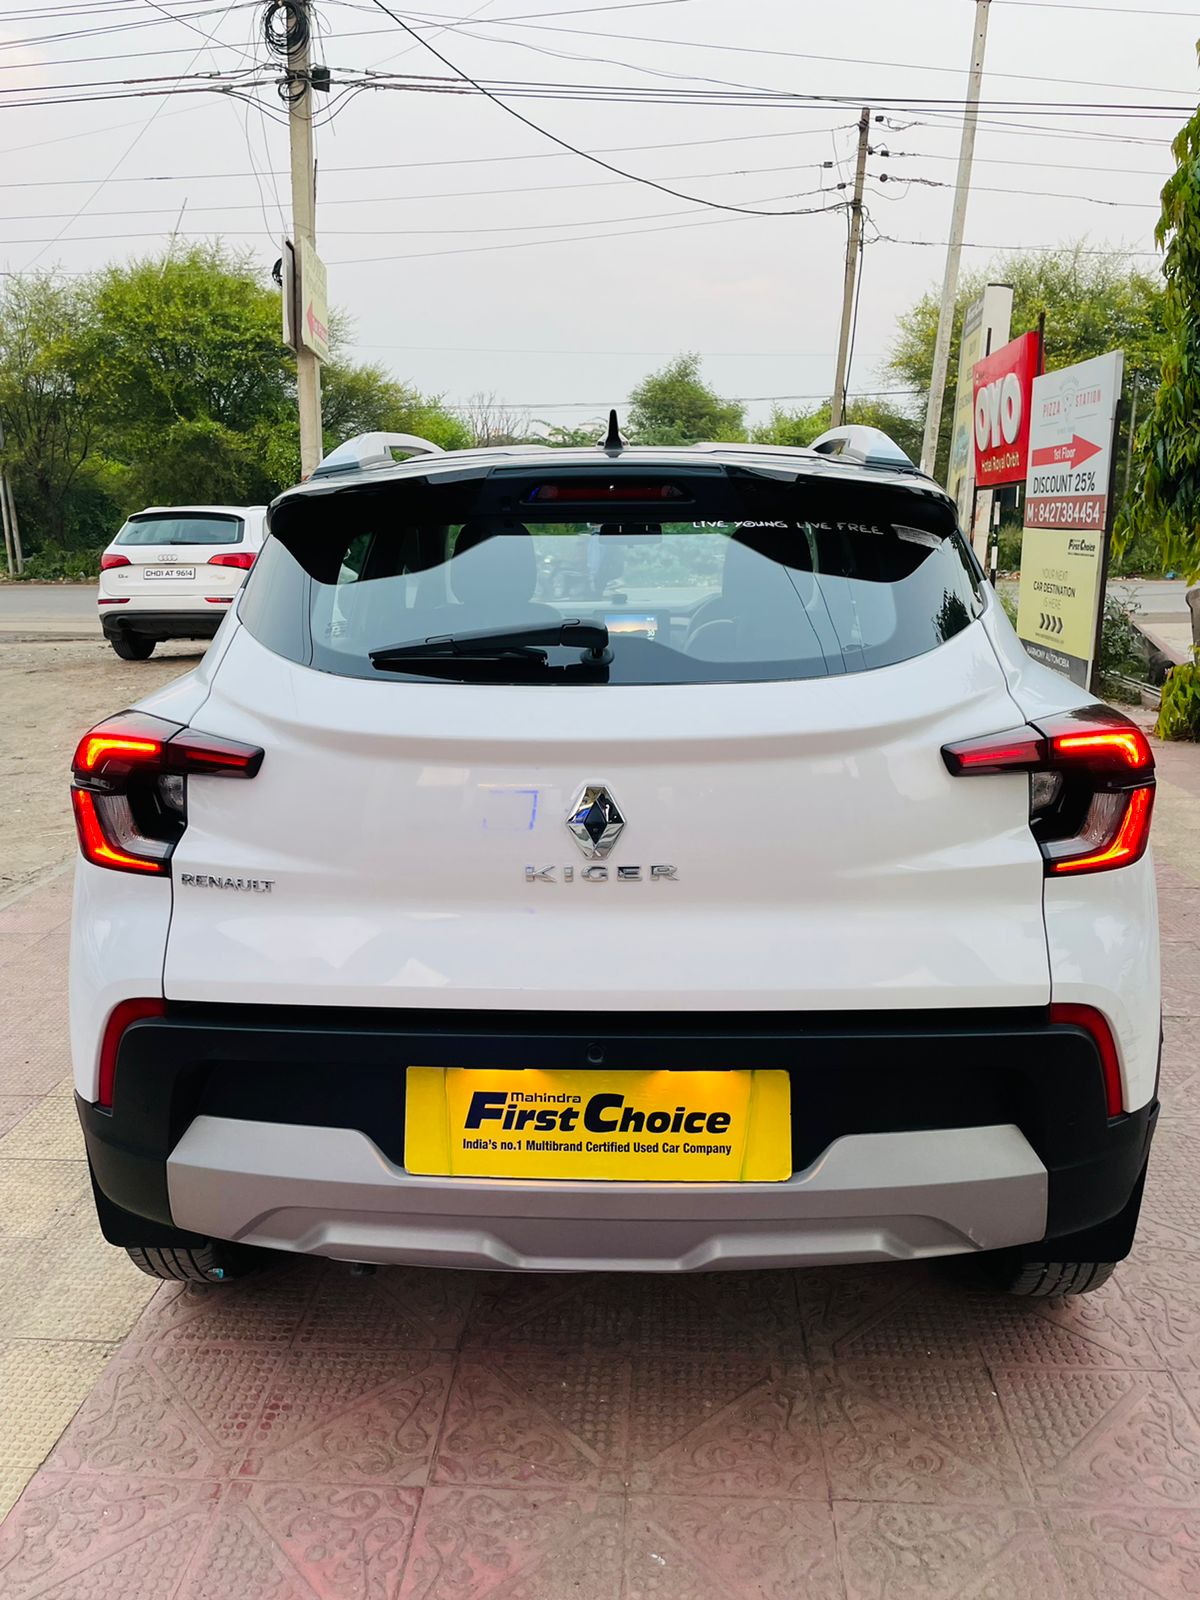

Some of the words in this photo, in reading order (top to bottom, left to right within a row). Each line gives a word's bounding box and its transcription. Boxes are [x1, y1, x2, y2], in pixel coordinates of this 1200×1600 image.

[975, 372, 1021, 452] OYO
[1042, 401, 1060, 418] PIZZA
[1076, 389, 1101, 407] STATION
[982, 459, 992, 472] Hotel
[992, 455, 1006, 472] Royal
[1006, 451, 1020, 469] Orbit
[1062, 447, 1076, 459] Floor
[1033, 474, 1073, 494] DISCOUNT
[1074, 471, 1096, 492] 25%
[692, 520, 725, 528] LIVE
[734, 520, 788, 529] YOUNG
[796, 521, 832, 530] LIVE
[837, 522, 884, 535] FREE
[1033, 581, 1043, 592] CAR
[1043, 582, 1076, 598] DESTINATION
[181, 873, 275, 893] RENAULT
[525, 864, 680, 883] KIGER
[511, 1092, 581, 1103] Mahindra
[463, 1091, 580, 1132] First
[583, 1093, 732, 1134] Choice
[462, 1138, 497, 1151] India's
[500, 1140, 522, 1151] no.1
[526, 1140, 582, 1152] Multibrand
[586, 1140, 630, 1153] Certified
[633, 1142, 659, 1154] Used
[662, 1143, 681, 1154] Car
[683, 1143, 732, 1156] Company
